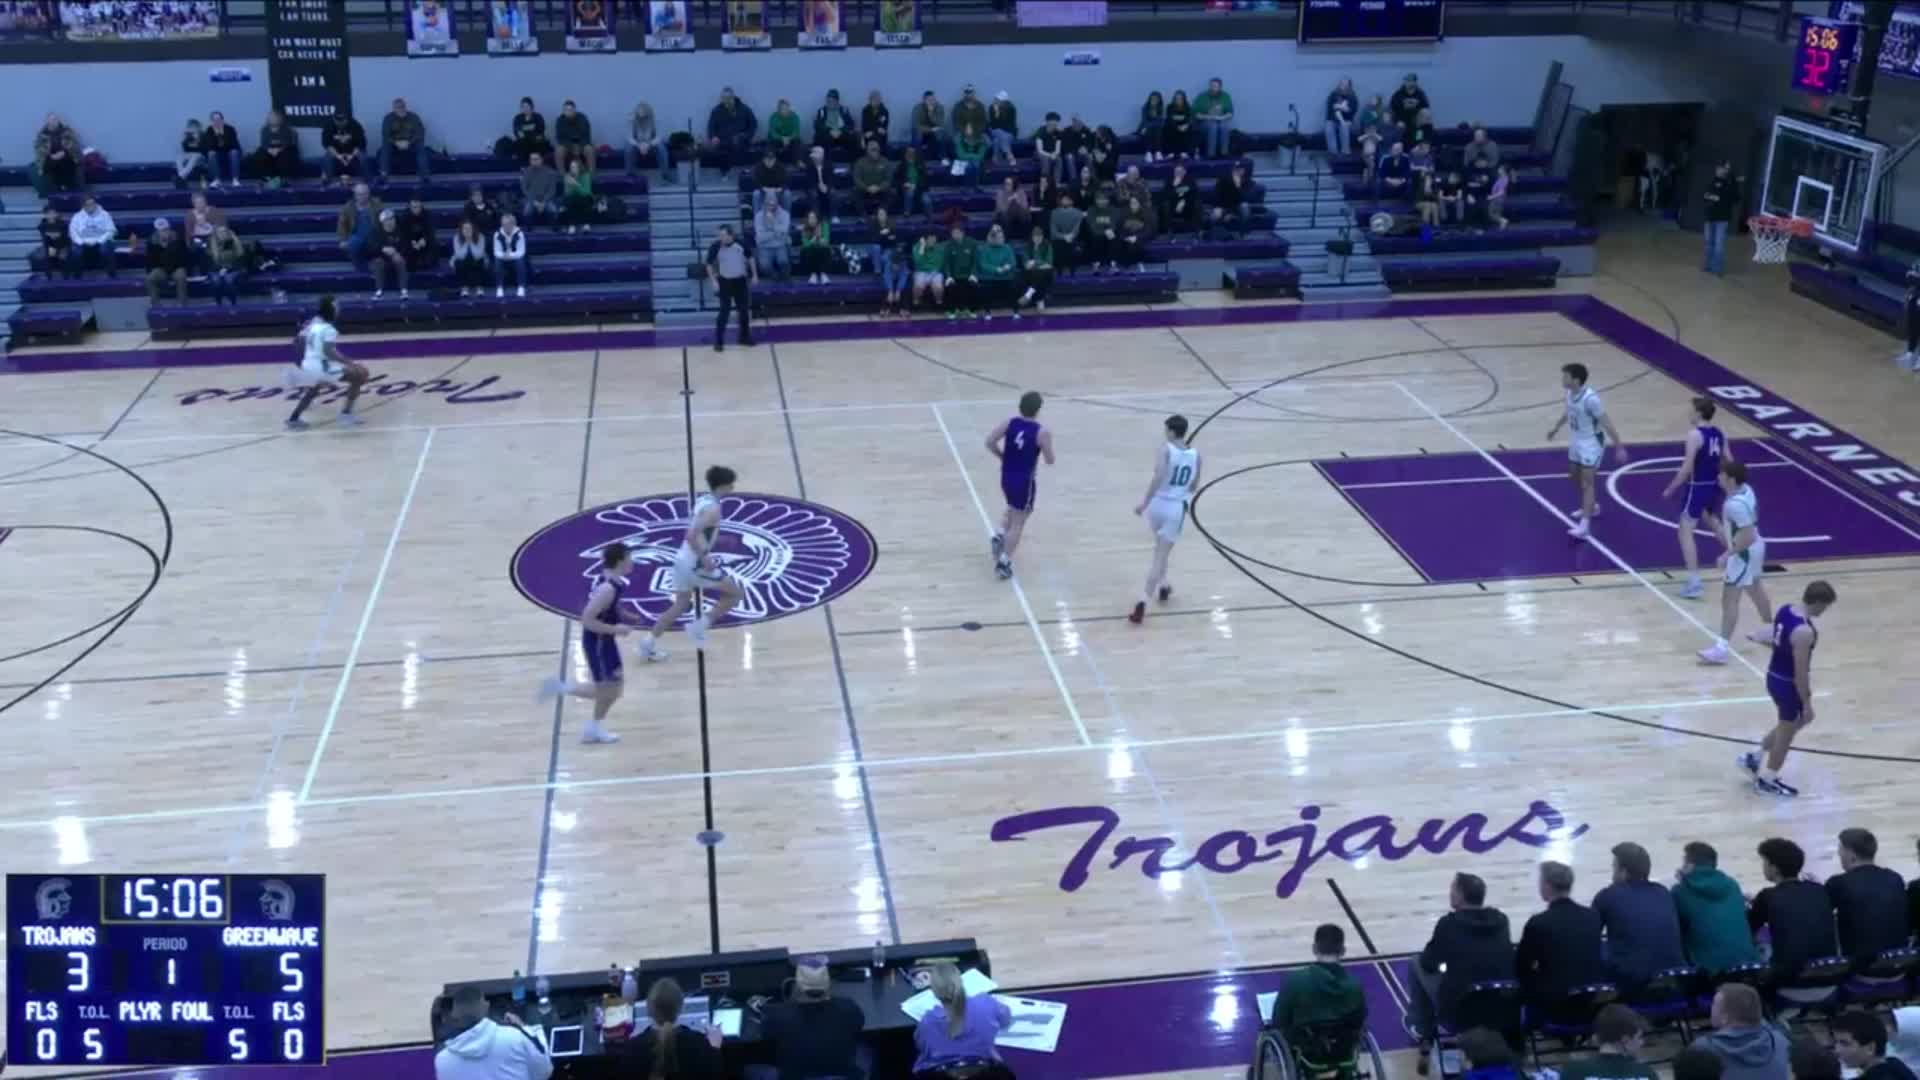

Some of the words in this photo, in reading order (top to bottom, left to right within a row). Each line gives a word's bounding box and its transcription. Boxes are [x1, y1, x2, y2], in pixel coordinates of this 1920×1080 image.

[302, 76, 316, 86] AM
[319, 76, 326, 86] A
[1013, 430, 1025, 449] 4
[1169, 464, 1192, 486] 10
[990, 800, 1591, 900] Trojans
